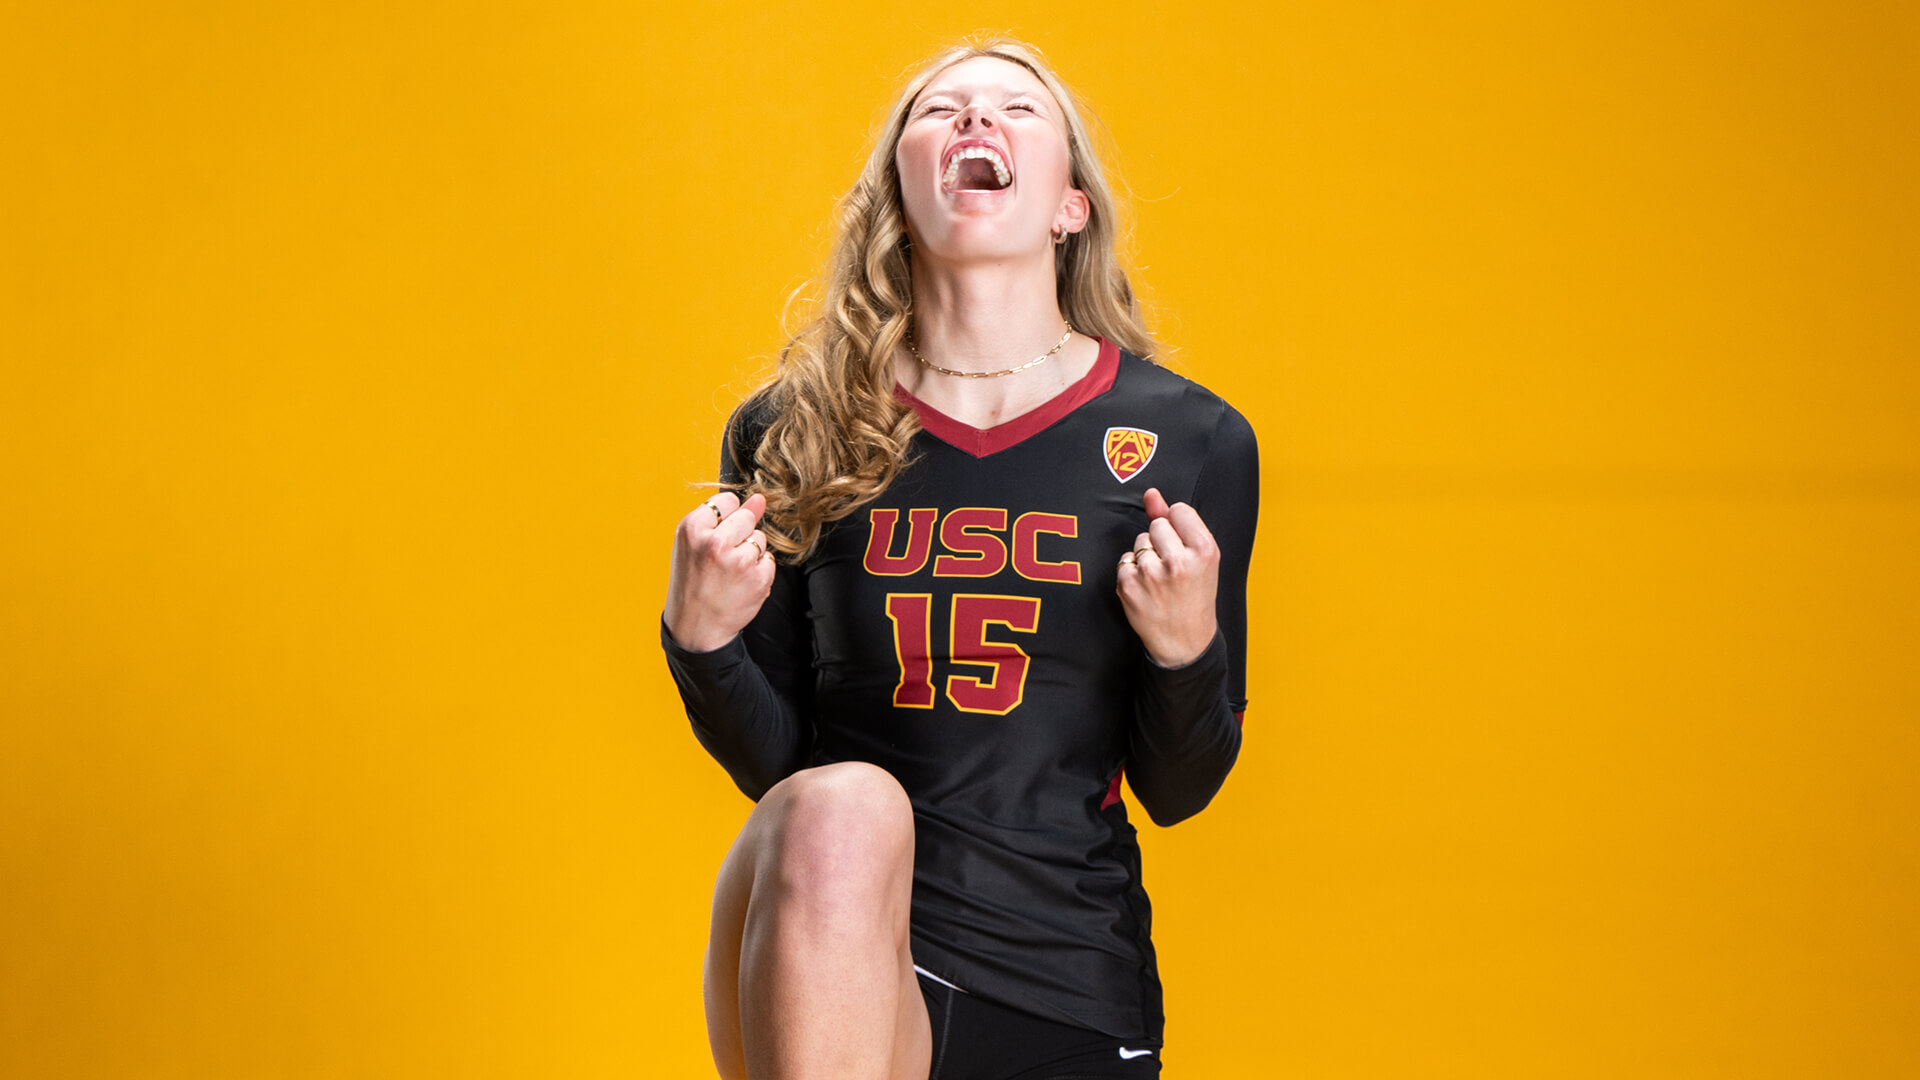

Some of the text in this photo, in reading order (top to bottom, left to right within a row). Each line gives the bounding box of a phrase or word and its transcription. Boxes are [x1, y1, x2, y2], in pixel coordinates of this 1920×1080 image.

[1107, 430, 1154, 463] PAC
[1113, 451, 1140, 472] 12
[863, 507, 1082, 585] USC
[885, 593, 1041, 716] 15
